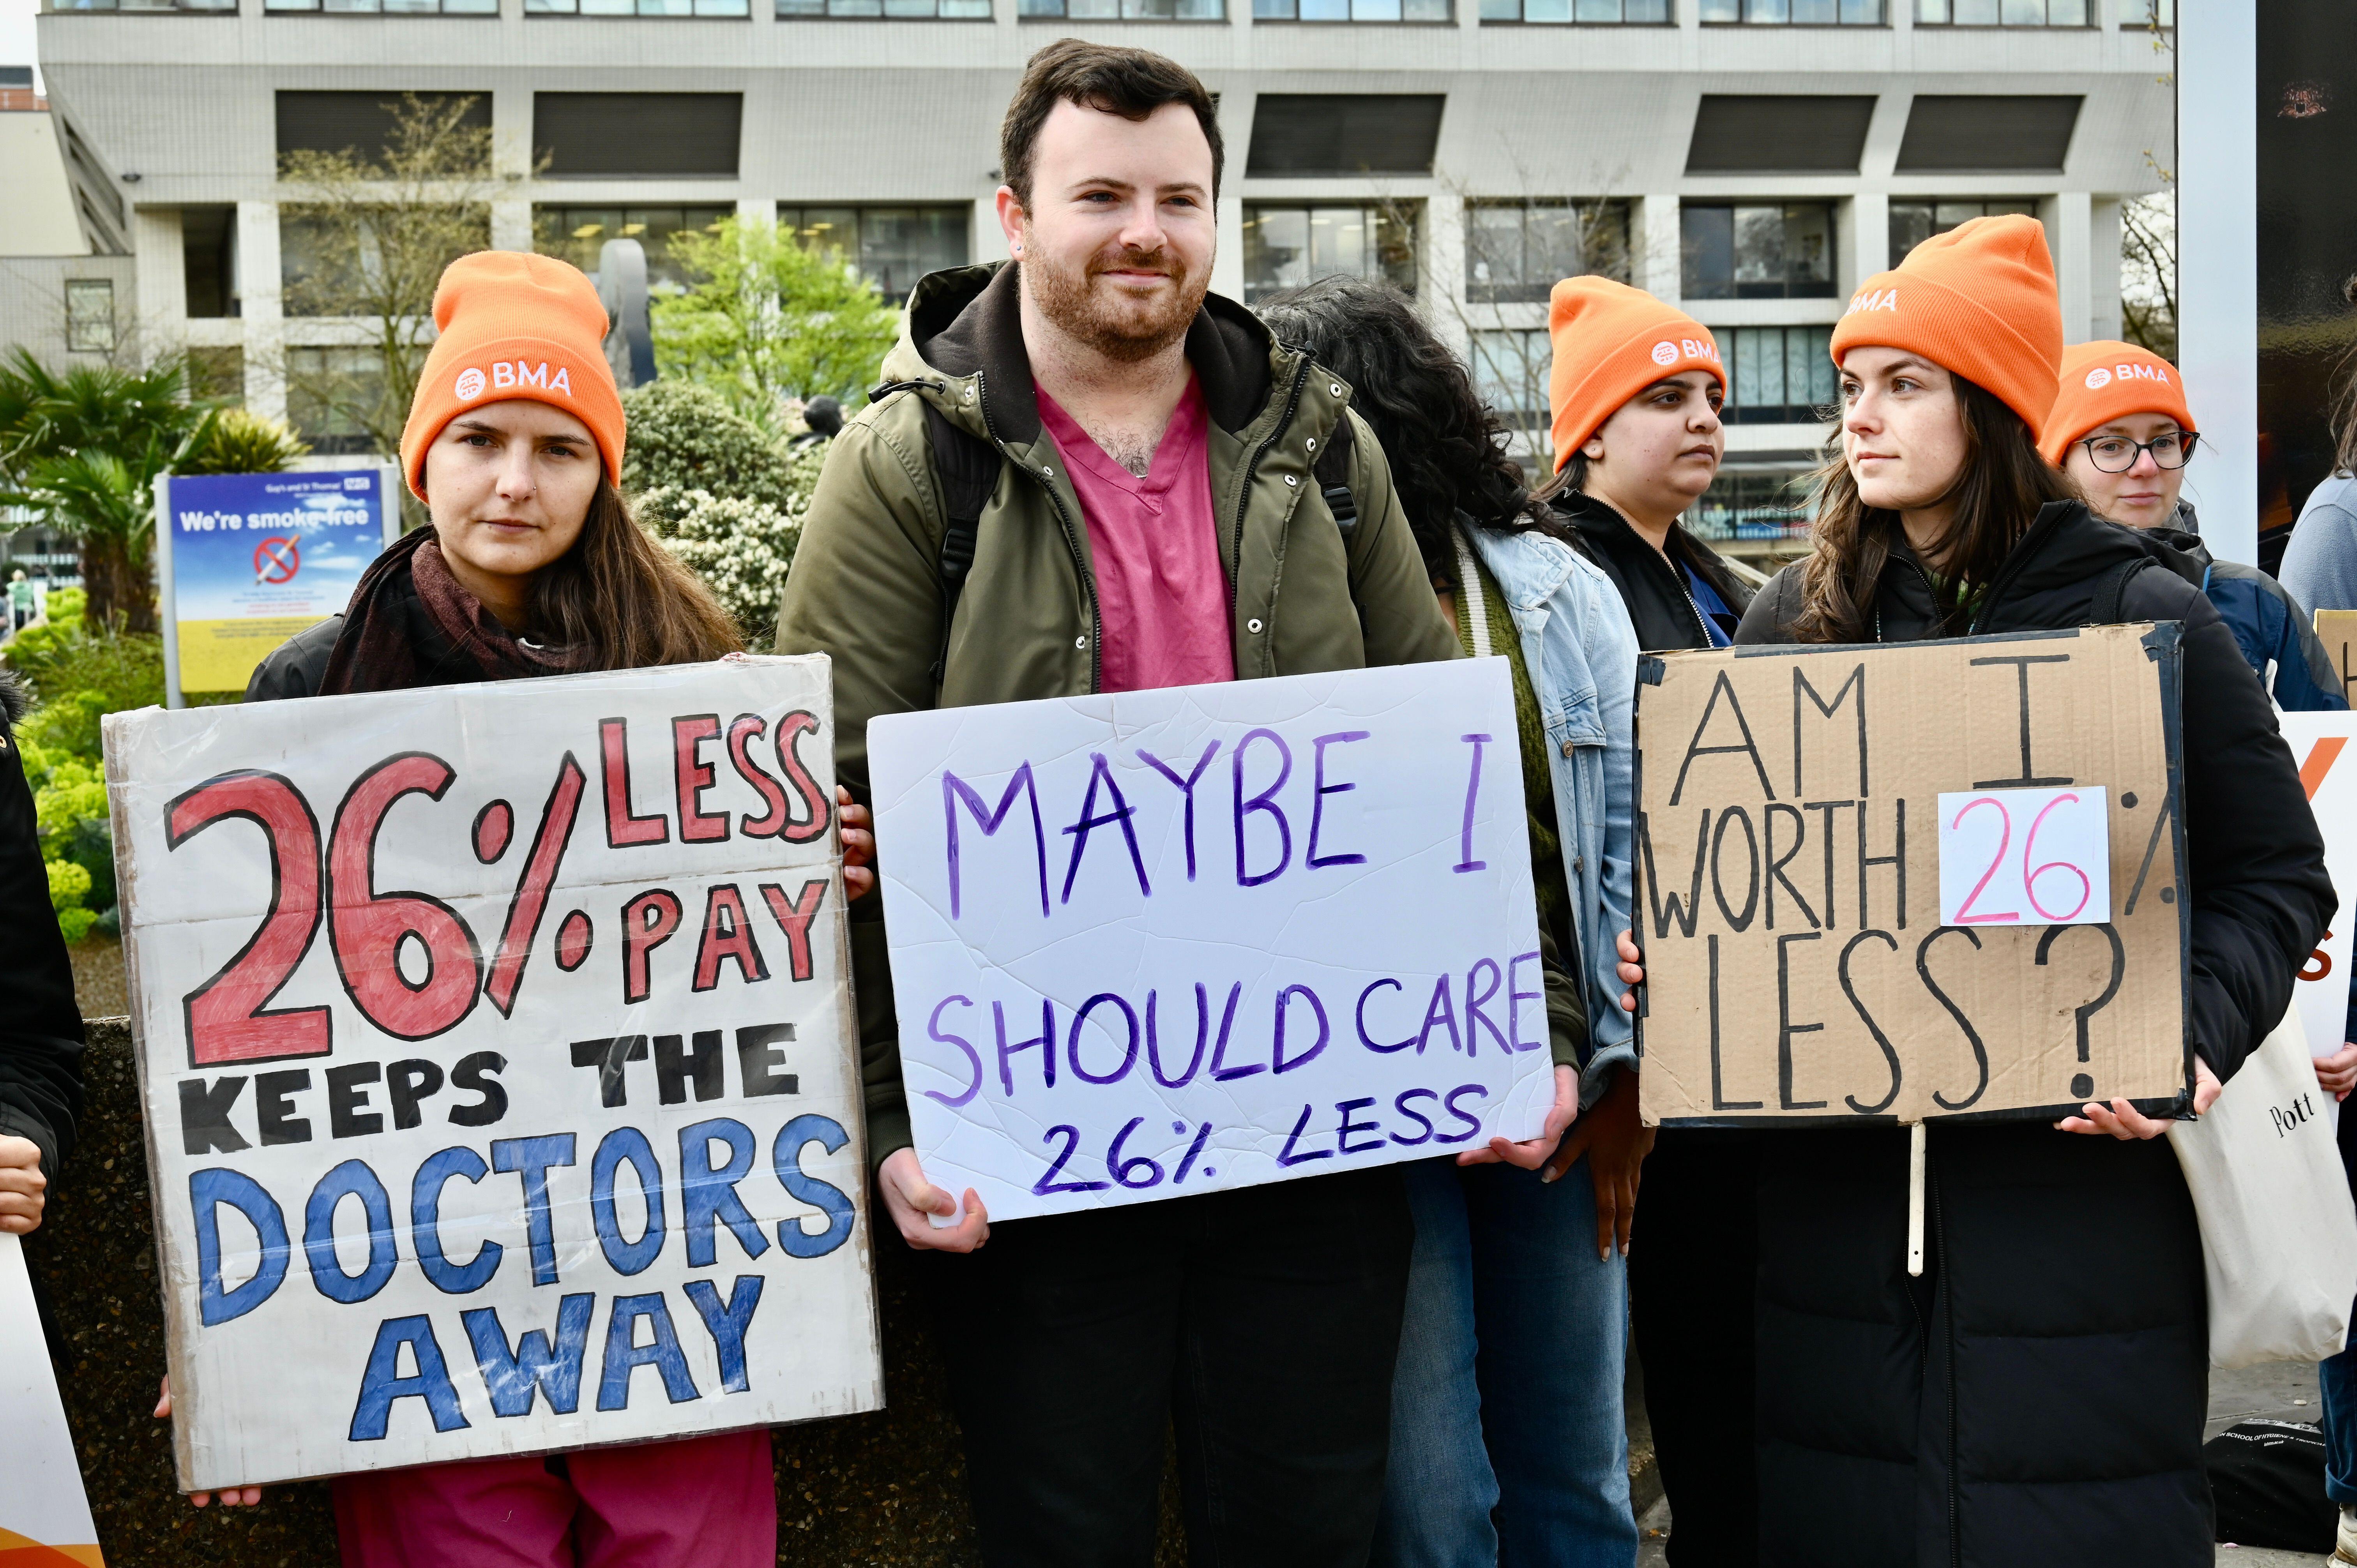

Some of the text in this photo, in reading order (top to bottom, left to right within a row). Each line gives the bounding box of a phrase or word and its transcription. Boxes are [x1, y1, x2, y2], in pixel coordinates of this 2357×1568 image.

[1681, 339, 1722, 364] BMA
[1845, 289, 1897, 316] BMA
[493, 360, 572, 396] BMA
[2116, 364, 2170, 386] BMA
[180, 510, 242, 531] We're
[600, 709, 831, 849] LESS
[1668, 653, 2074, 806] AM I
[942, 727, 1493, 920] MAYBE I
[1639, 797, 1906, 939] WORTH
[165, 750, 593, 1068] 26%
[621, 879, 829, 1005] PAY
[177, 1023, 799, 1155] KEEPS THE
[924, 950, 1542, 1108] SHOULD CARE
[1031, 1083, 1489, 1196] 26% LESS
[189, 1112, 857, 1328] DOCTORS
[348, 1275, 765, 1442] AWAY
[2226, 1432, 2253, 1441] SCHOOL
